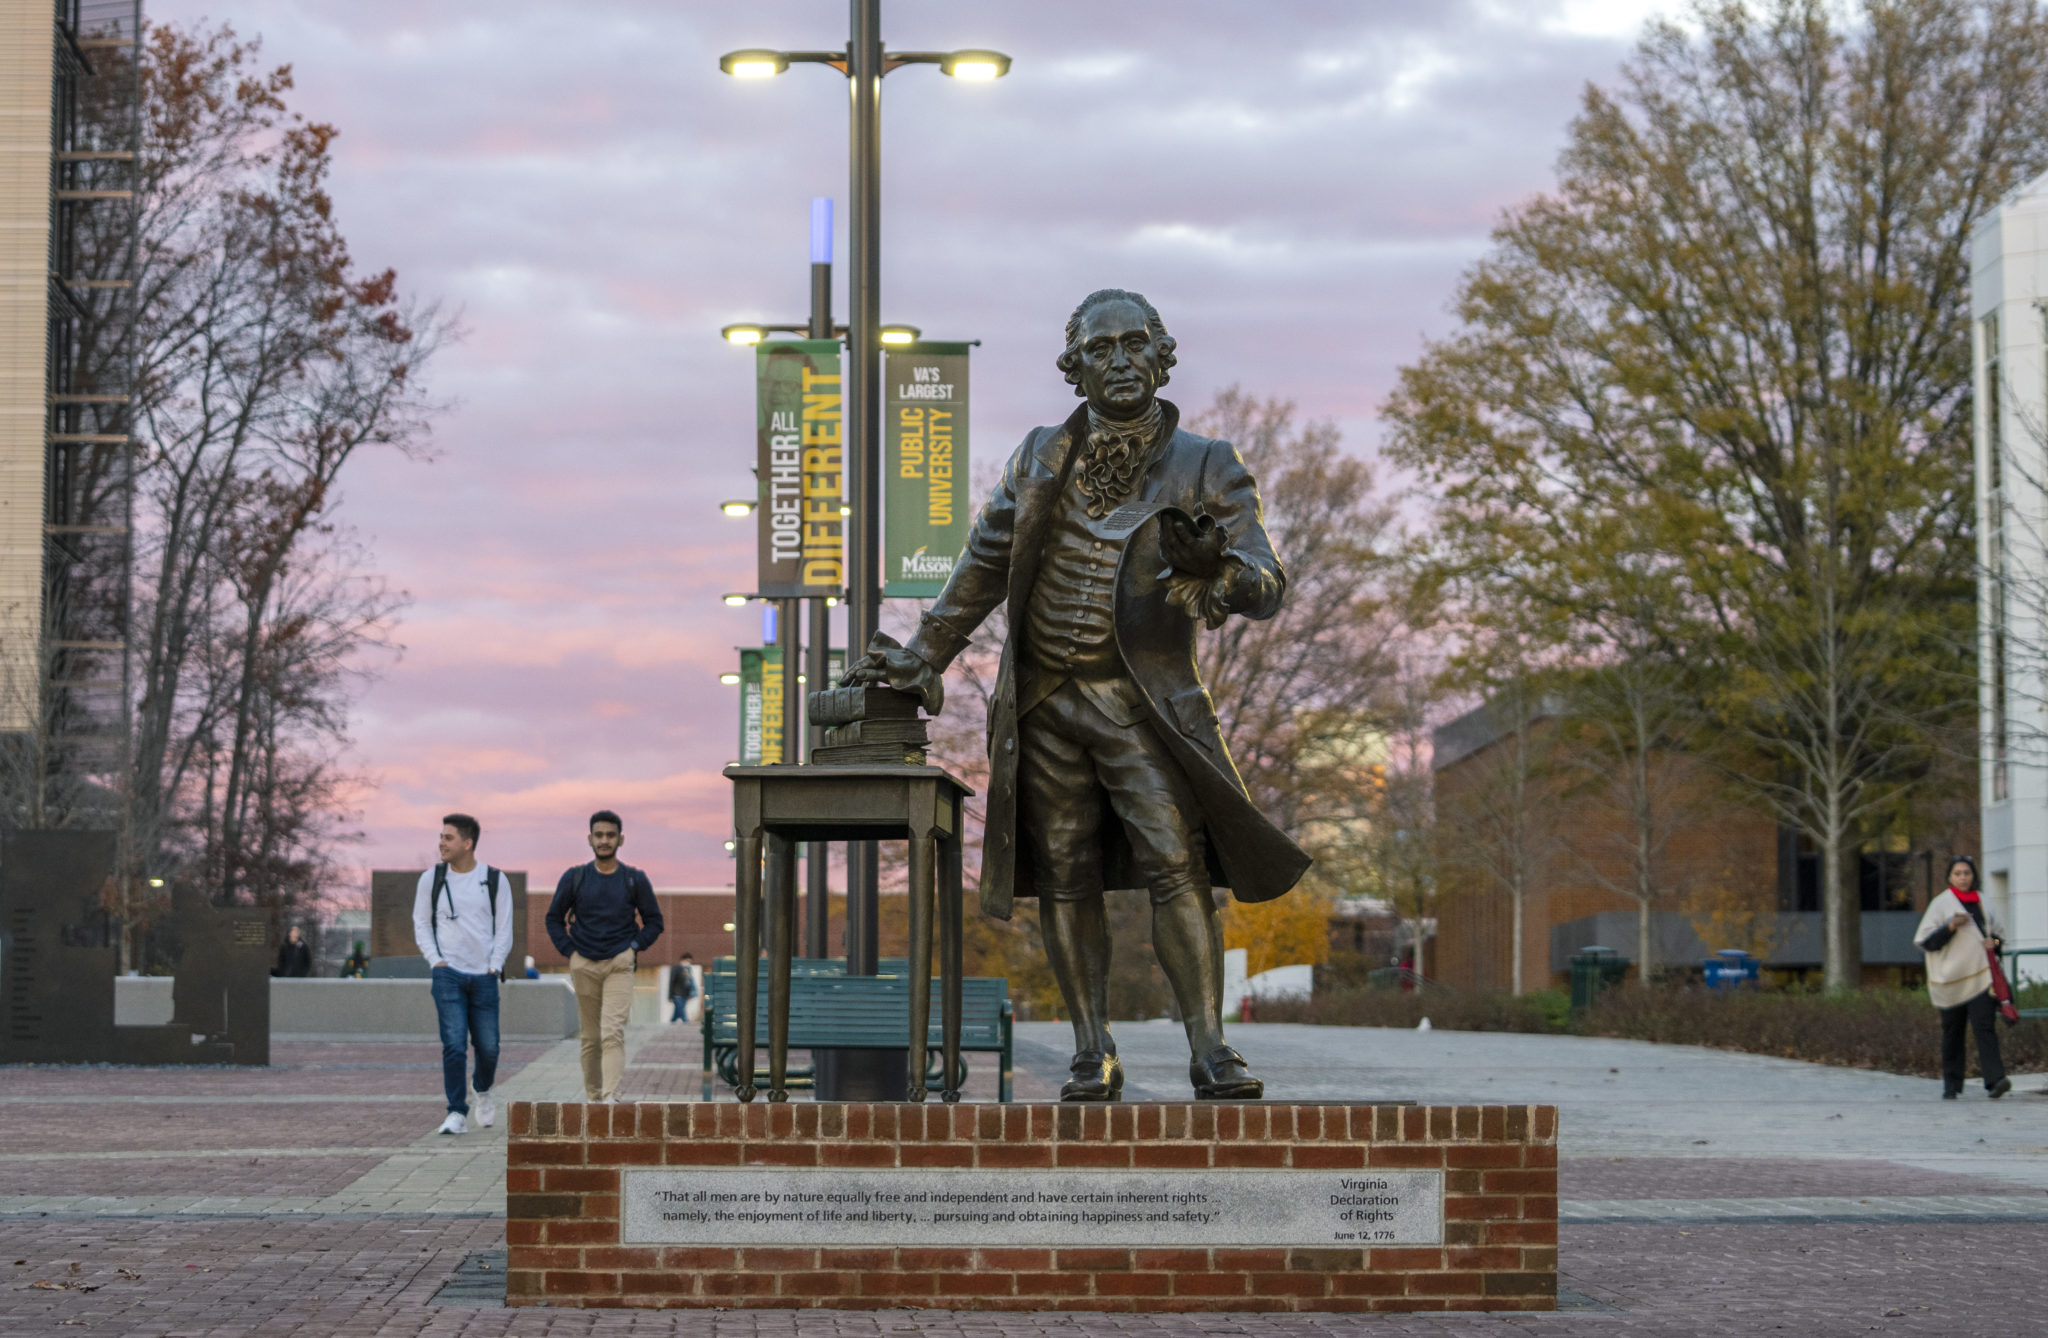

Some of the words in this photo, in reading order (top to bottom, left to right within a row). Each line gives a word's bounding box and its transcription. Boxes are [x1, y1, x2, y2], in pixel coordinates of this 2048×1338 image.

[913, 366, 940, 382] VA'S
[899, 384, 954, 400] LARGEST
[771, 411, 799, 432] ALL
[900, 407, 924, 478] PUBLIC
[928, 408, 952, 526] UNIVERSITY
[802, 366, 842, 585] DIFFERENT
[771, 434, 801, 564] TOGETHER
[902, 556, 953, 572] MASON
[745, 694, 762, 761] TOGETHER
[1340, 1178, 1388, 1192] Virginia
[692, 1191, 707, 1202] all
[710, 1193, 737, 1202] men
[740, 1193, 761, 1202] are
[765, 1191, 780, 1205] by
[783, 1192, 824, 1202] nature
[826, 1191, 871, 1205] equally
[874, 1191, 901, 1202] free
[903, 1191, 927, 1203] and
[930, 1191, 1009, 1205] independent
[1012, 1191, 1035, 1203] and
[1038, 1191, 1068, 1203] have
[1071, 1192, 1113, 1203] certain
[1117, 1192, 1168, 1203] inherent
[1172, 1191, 1208, 1205] rights
[1330, 1194, 1399, 1206] Declaration
[663, 1210, 711, 1224] namely,
[714, 1210, 735, 1221] the
[738, 1211, 804, 1224] enjoyment
[806, 1210, 821, 1221] of
[823, 1210, 842, 1221] life
[845, 1210, 868, 1222] and
[872, 1210, 916, 1224] liberty,
[933, 1211, 989, 1224] pursuing
[992, 1210, 1016, 1222] and
[1018, 1210, 1079, 1224] obtaining
[1082, 1210, 1143, 1224] happiness
[1146, 1210, 1169, 1222] and
[1340, 1209, 1353, 1221] of
[1356, 1209, 1394, 1223] Rights
[1333, 1231, 1355, 1240] June
[1358, 1231, 1371, 1240] 12,
[1373, 1231, 1396, 1240] 1776
